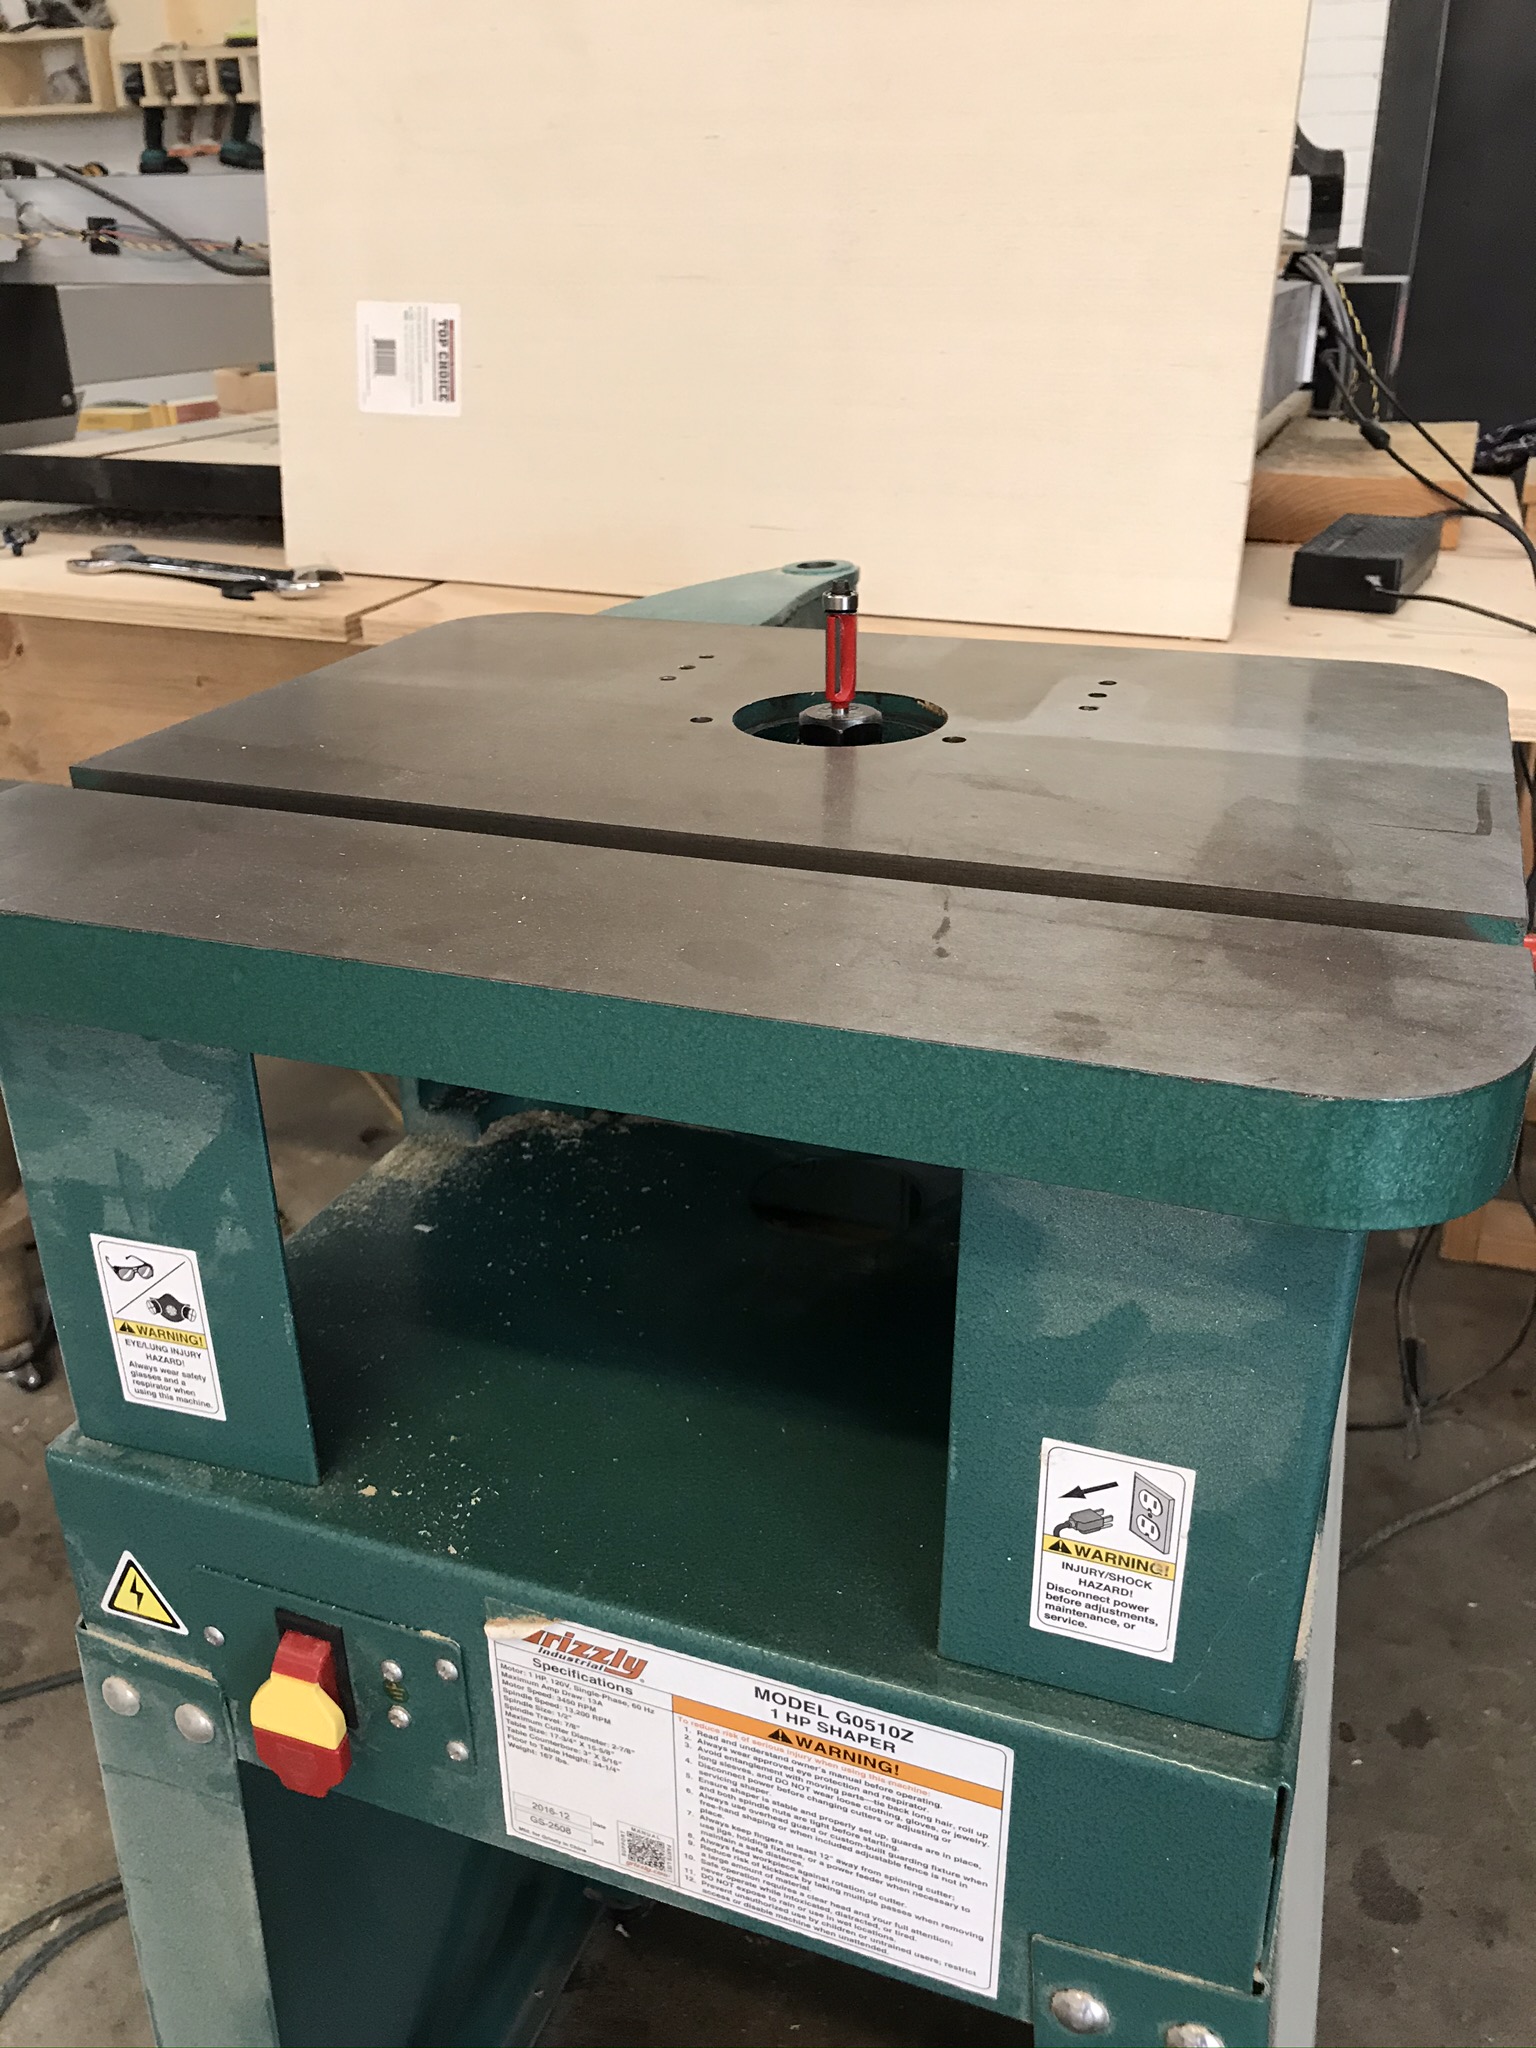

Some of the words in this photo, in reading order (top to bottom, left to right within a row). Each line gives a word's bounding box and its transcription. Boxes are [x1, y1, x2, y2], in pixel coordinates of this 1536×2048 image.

[438, 319, 449, 347] TOP
[438, 351, 449, 401] CHOICE
[124, 1337, 168, 1353] EYE/LUNG
[169, 1346, 201, 1359] INJURY
[135, 1324, 203, 1346] WARNING!
[145, 1352, 185, 1367] HAZARD!
[1061, 1560, 1152, 1589] INJURY/SHOCK
[1078, 1577, 1133, 1598] HAZARD!
[1045, 1591, 1081, 1607] before
[1084, 1601, 1158, 1627] adjustments,
[1046, 1581, 1110, 1604] Disconnect
[1112, 1599, 1148, 1615] power
[1043, 1612, 1087, 1628] service.
[1044, 1601, 1119, 1627] maintenance,
[1123, 1622, 1134, 1630] or
[522, 1630, 649, 1680] rizzly
[538, 1646, 604, 1672] Industrial
[532, 1656, 632, 1698] Specifications
[754, 1686, 829, 1719] MODEL
[835, 1709, 913, 1744] G0510Z
[770, 1706, 777, 1719] 1
[785, 1711, 810, 1729] HP
[817, 1720, 895, 1754] SHAPER
[795, 1734, 899, 1776] WARNING!
[531, 1801, 570, 1820] 2016-12
